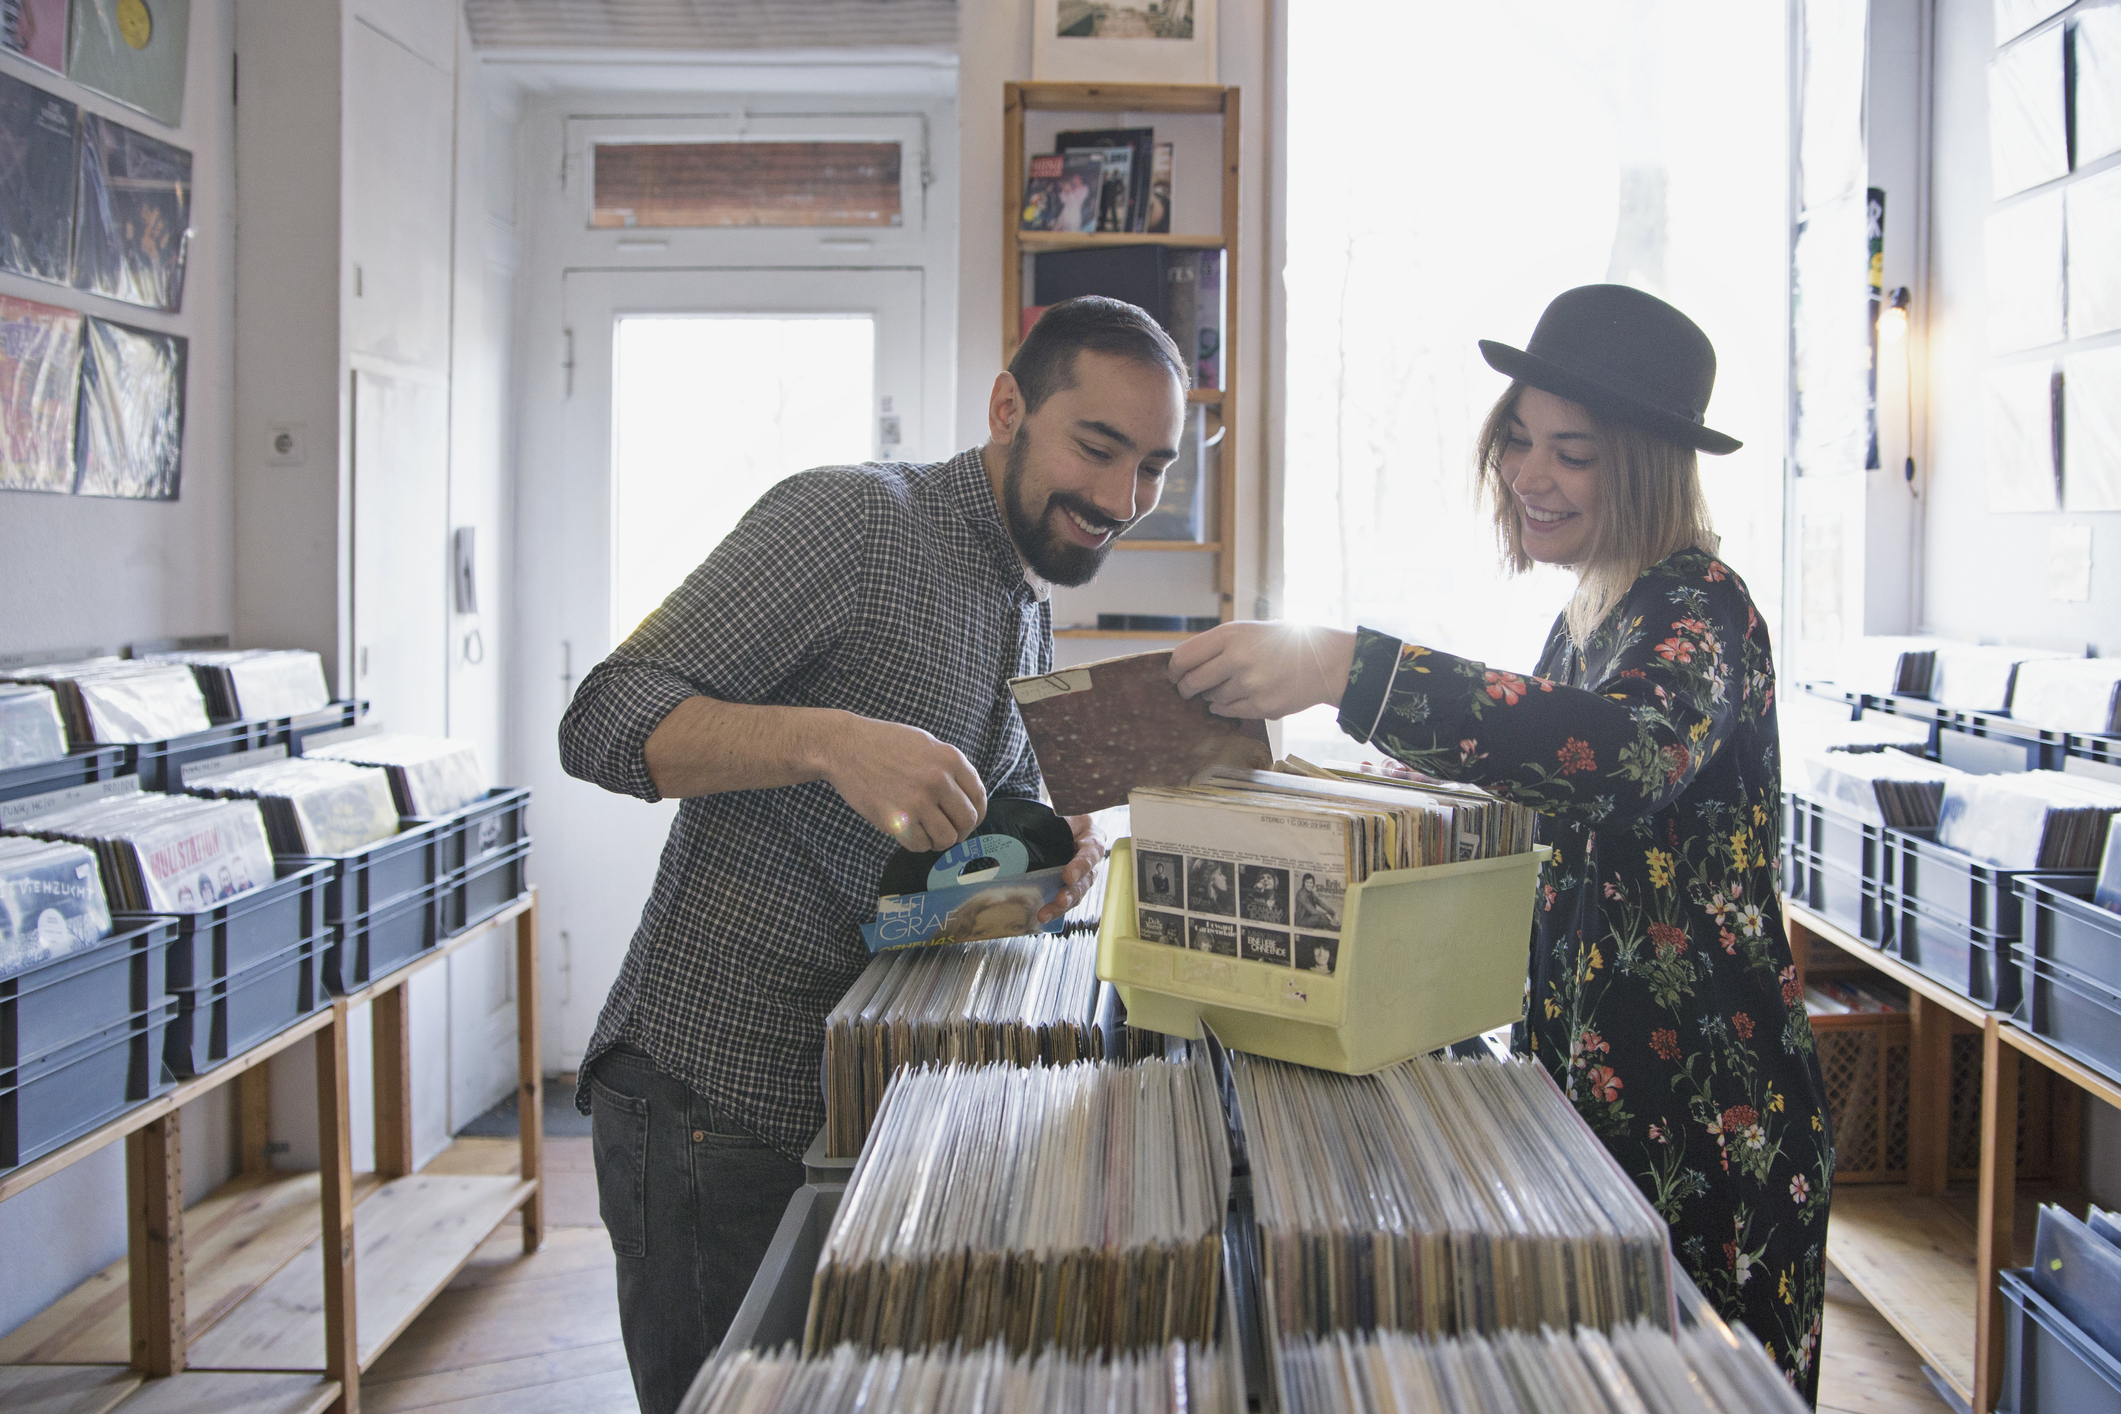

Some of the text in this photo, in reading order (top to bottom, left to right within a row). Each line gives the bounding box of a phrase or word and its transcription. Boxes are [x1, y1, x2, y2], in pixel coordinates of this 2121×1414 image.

[1260, 815, 1285, 825] STEREO
[150, 826, 220, 881] MÜLLSTATION
[881, 894, 925, 920] ELFI
[880, 909, 959, 941] GRAF
